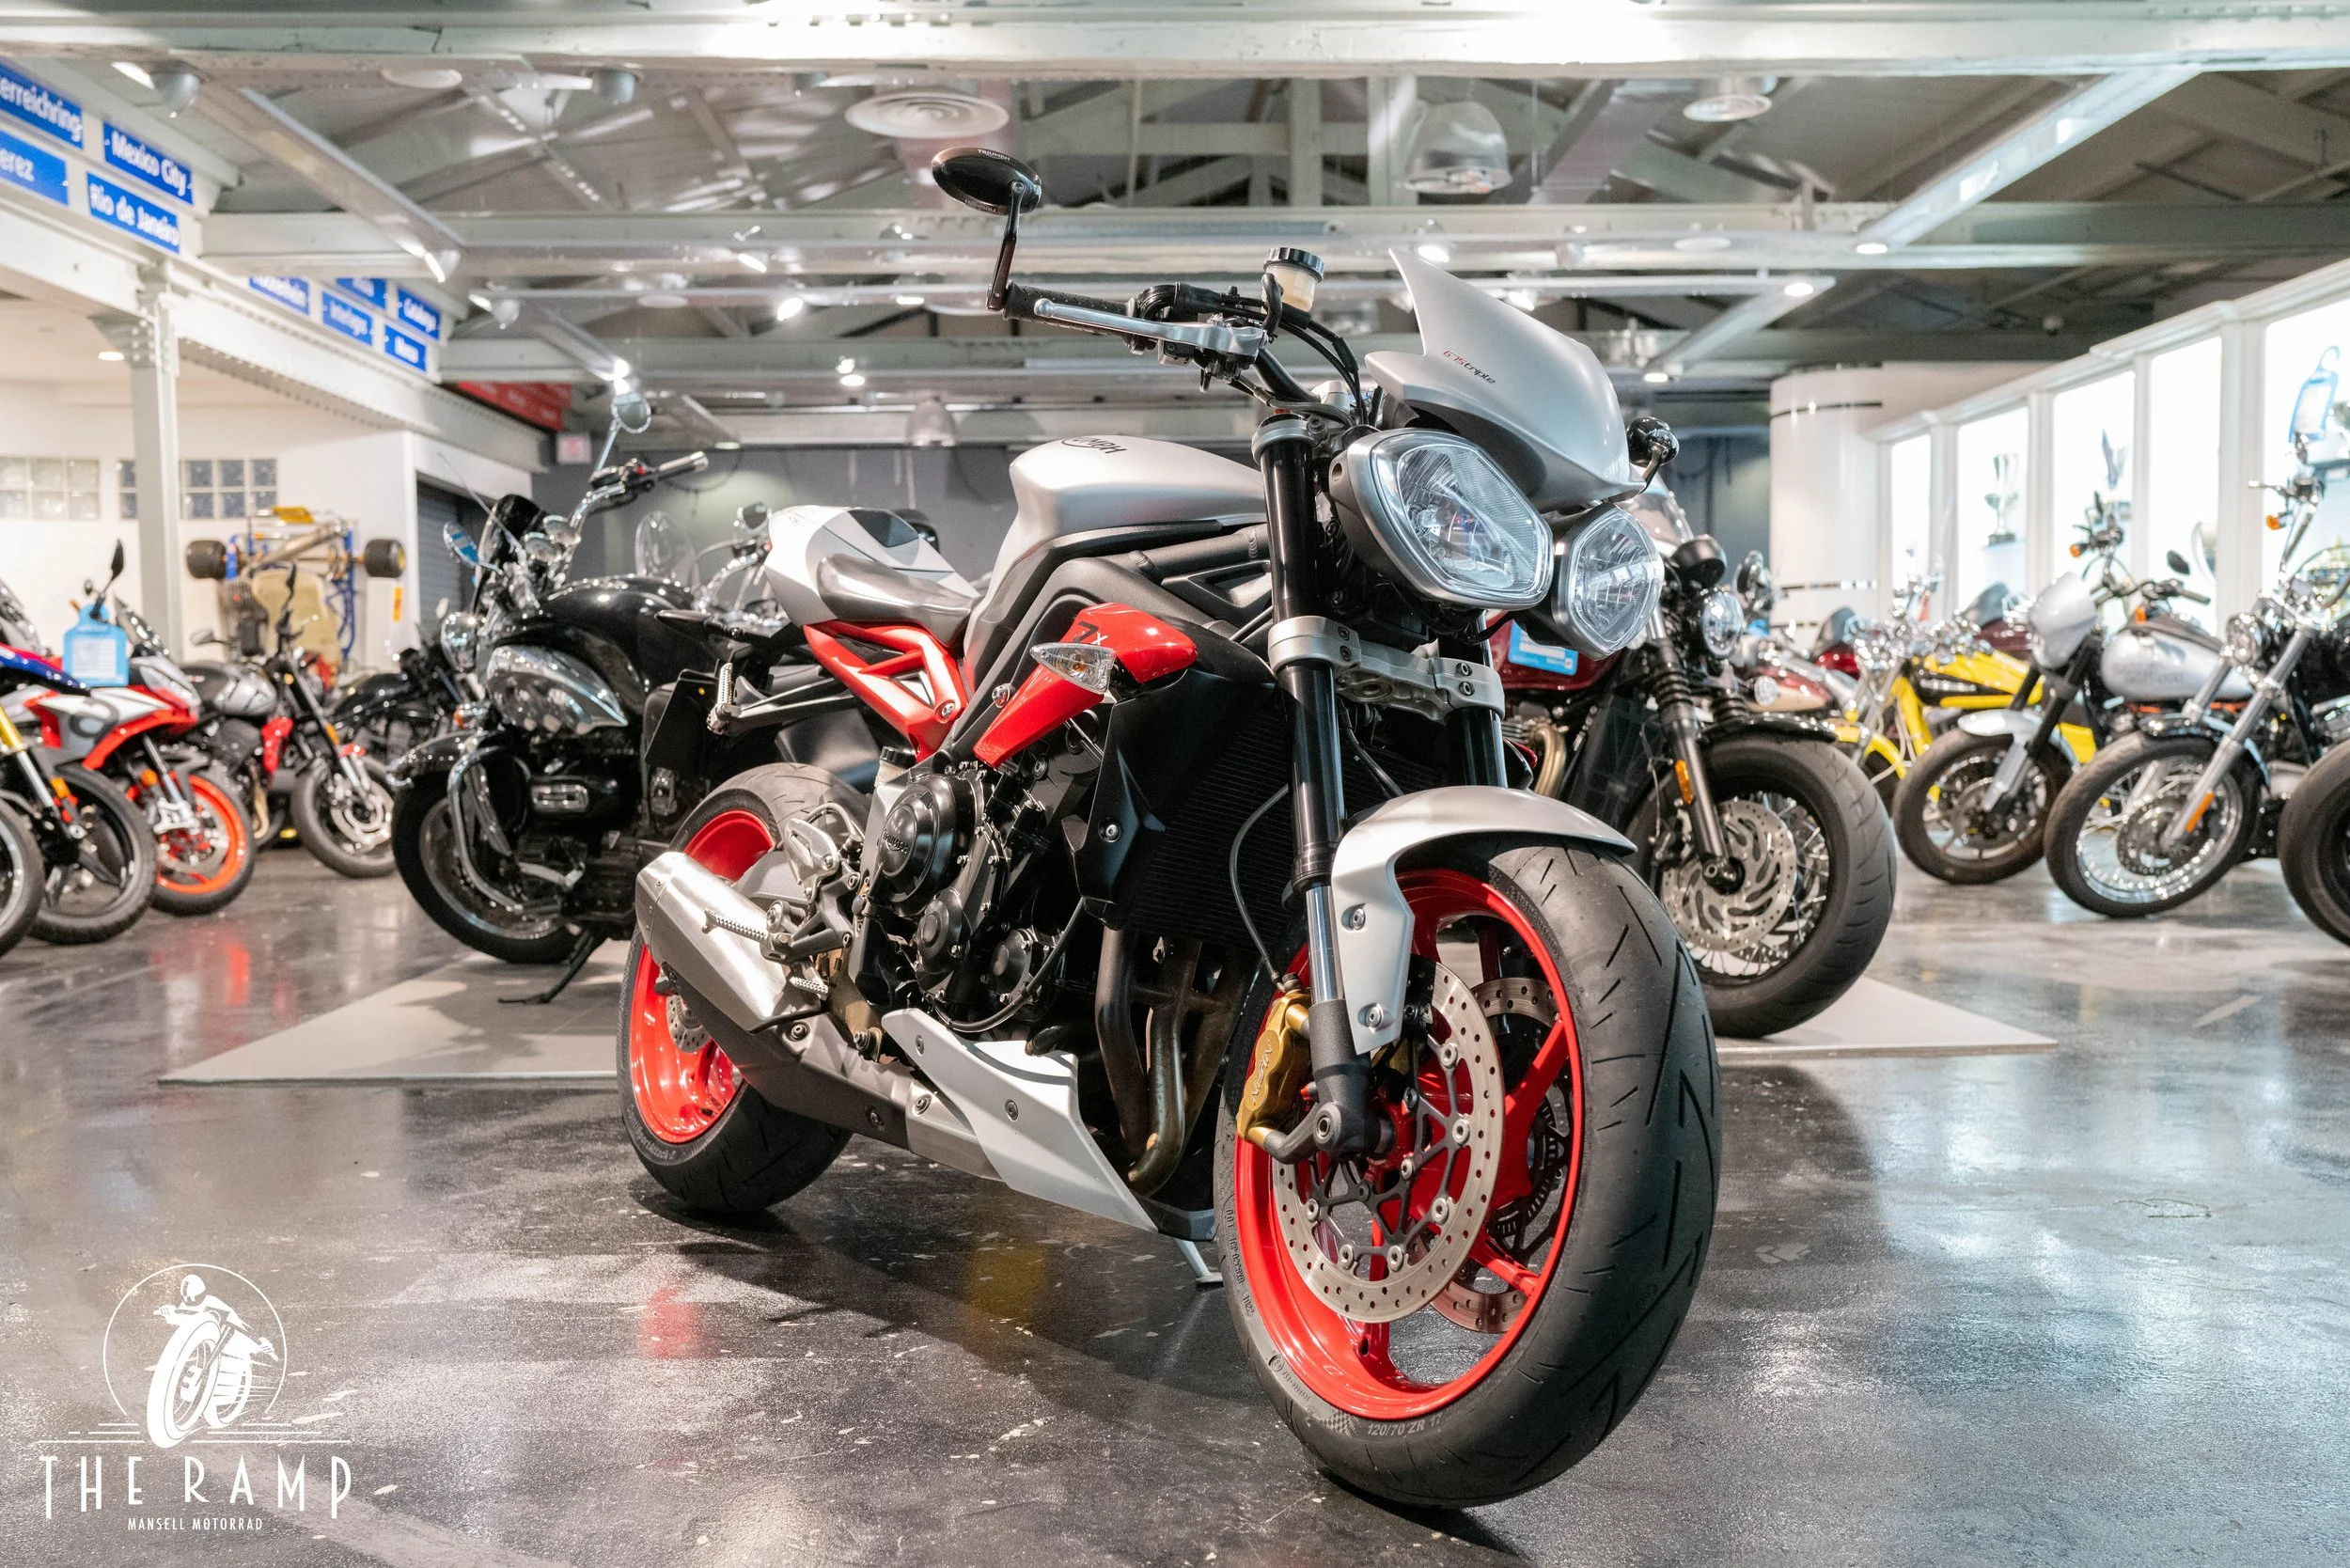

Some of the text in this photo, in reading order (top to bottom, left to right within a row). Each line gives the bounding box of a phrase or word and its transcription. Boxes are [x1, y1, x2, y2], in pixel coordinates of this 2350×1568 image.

[112, 132, 187, 196] Mexico City
[978, 149, 1010, 161] TRIUMPH
[89, 182, 180, 246] Rio de Janeiro
[1367, 1412, 1444, 1437] 120/70 ZR 17
